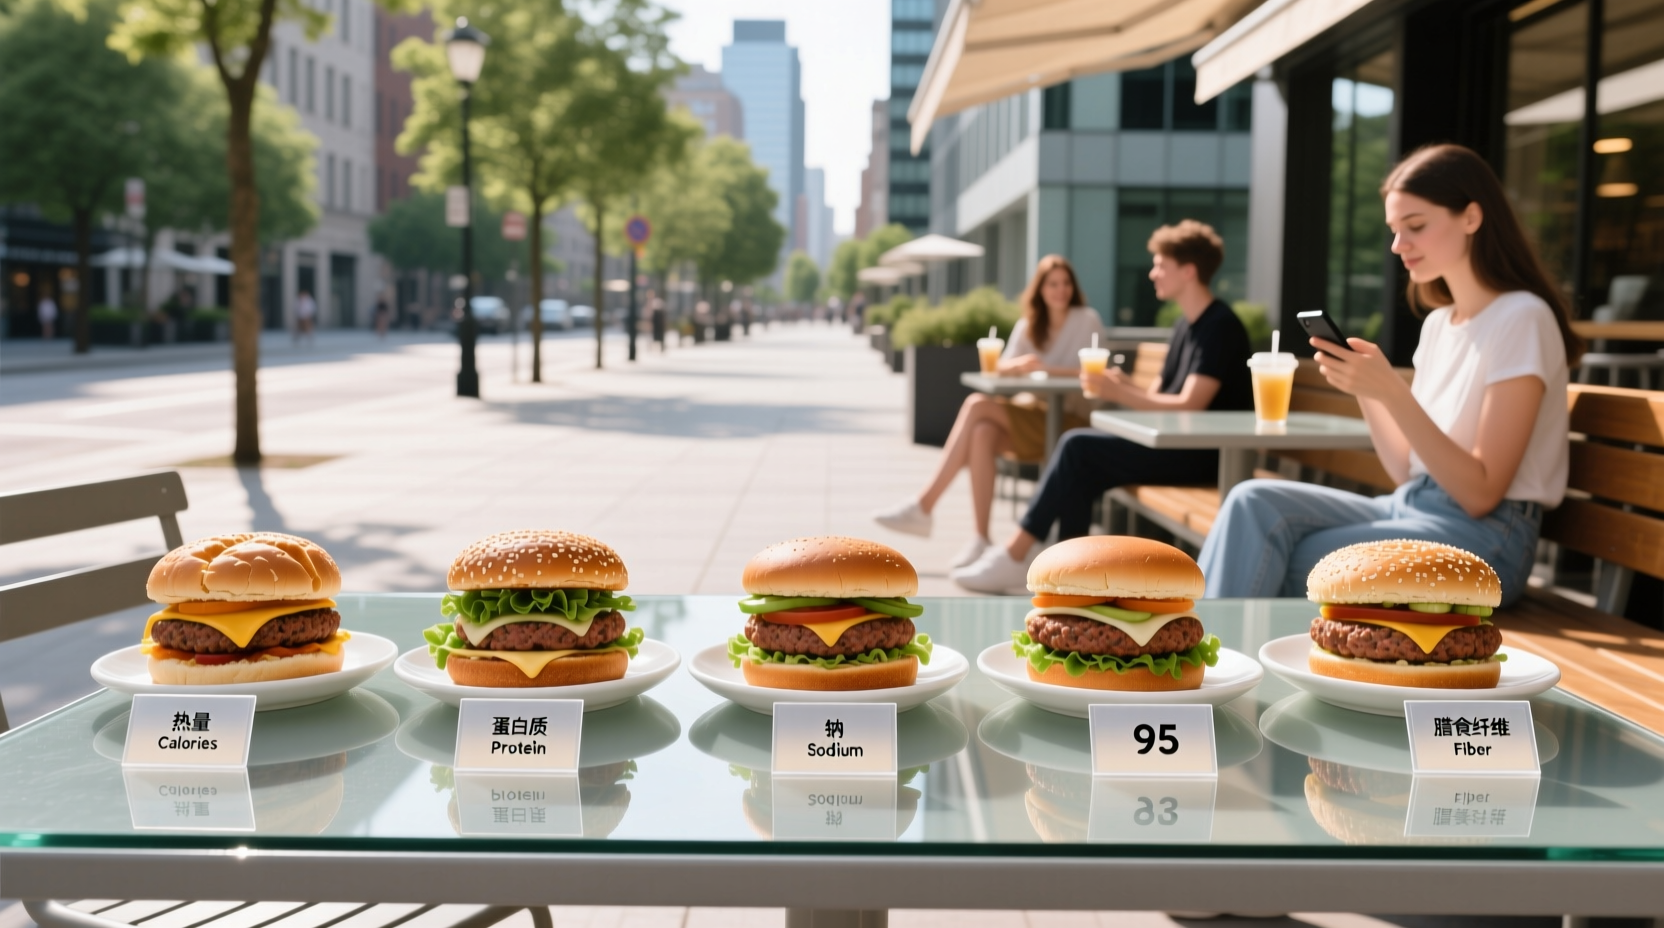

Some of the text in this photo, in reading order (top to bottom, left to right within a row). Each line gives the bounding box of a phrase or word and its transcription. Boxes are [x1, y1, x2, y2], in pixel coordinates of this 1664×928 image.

[171, 710, 212, 732] 热量
[491, 716, 549, 737] 蛋白质
[824, 718, 844, 739] 钠
[157, 735, 218, 750] Calories
[491, 740, 546, 755] Protein
[1133, 723, 1180, 755] 95
[807, 742, 864, 758] Sodium
[1453, 741, 1492, 756] Fiber
